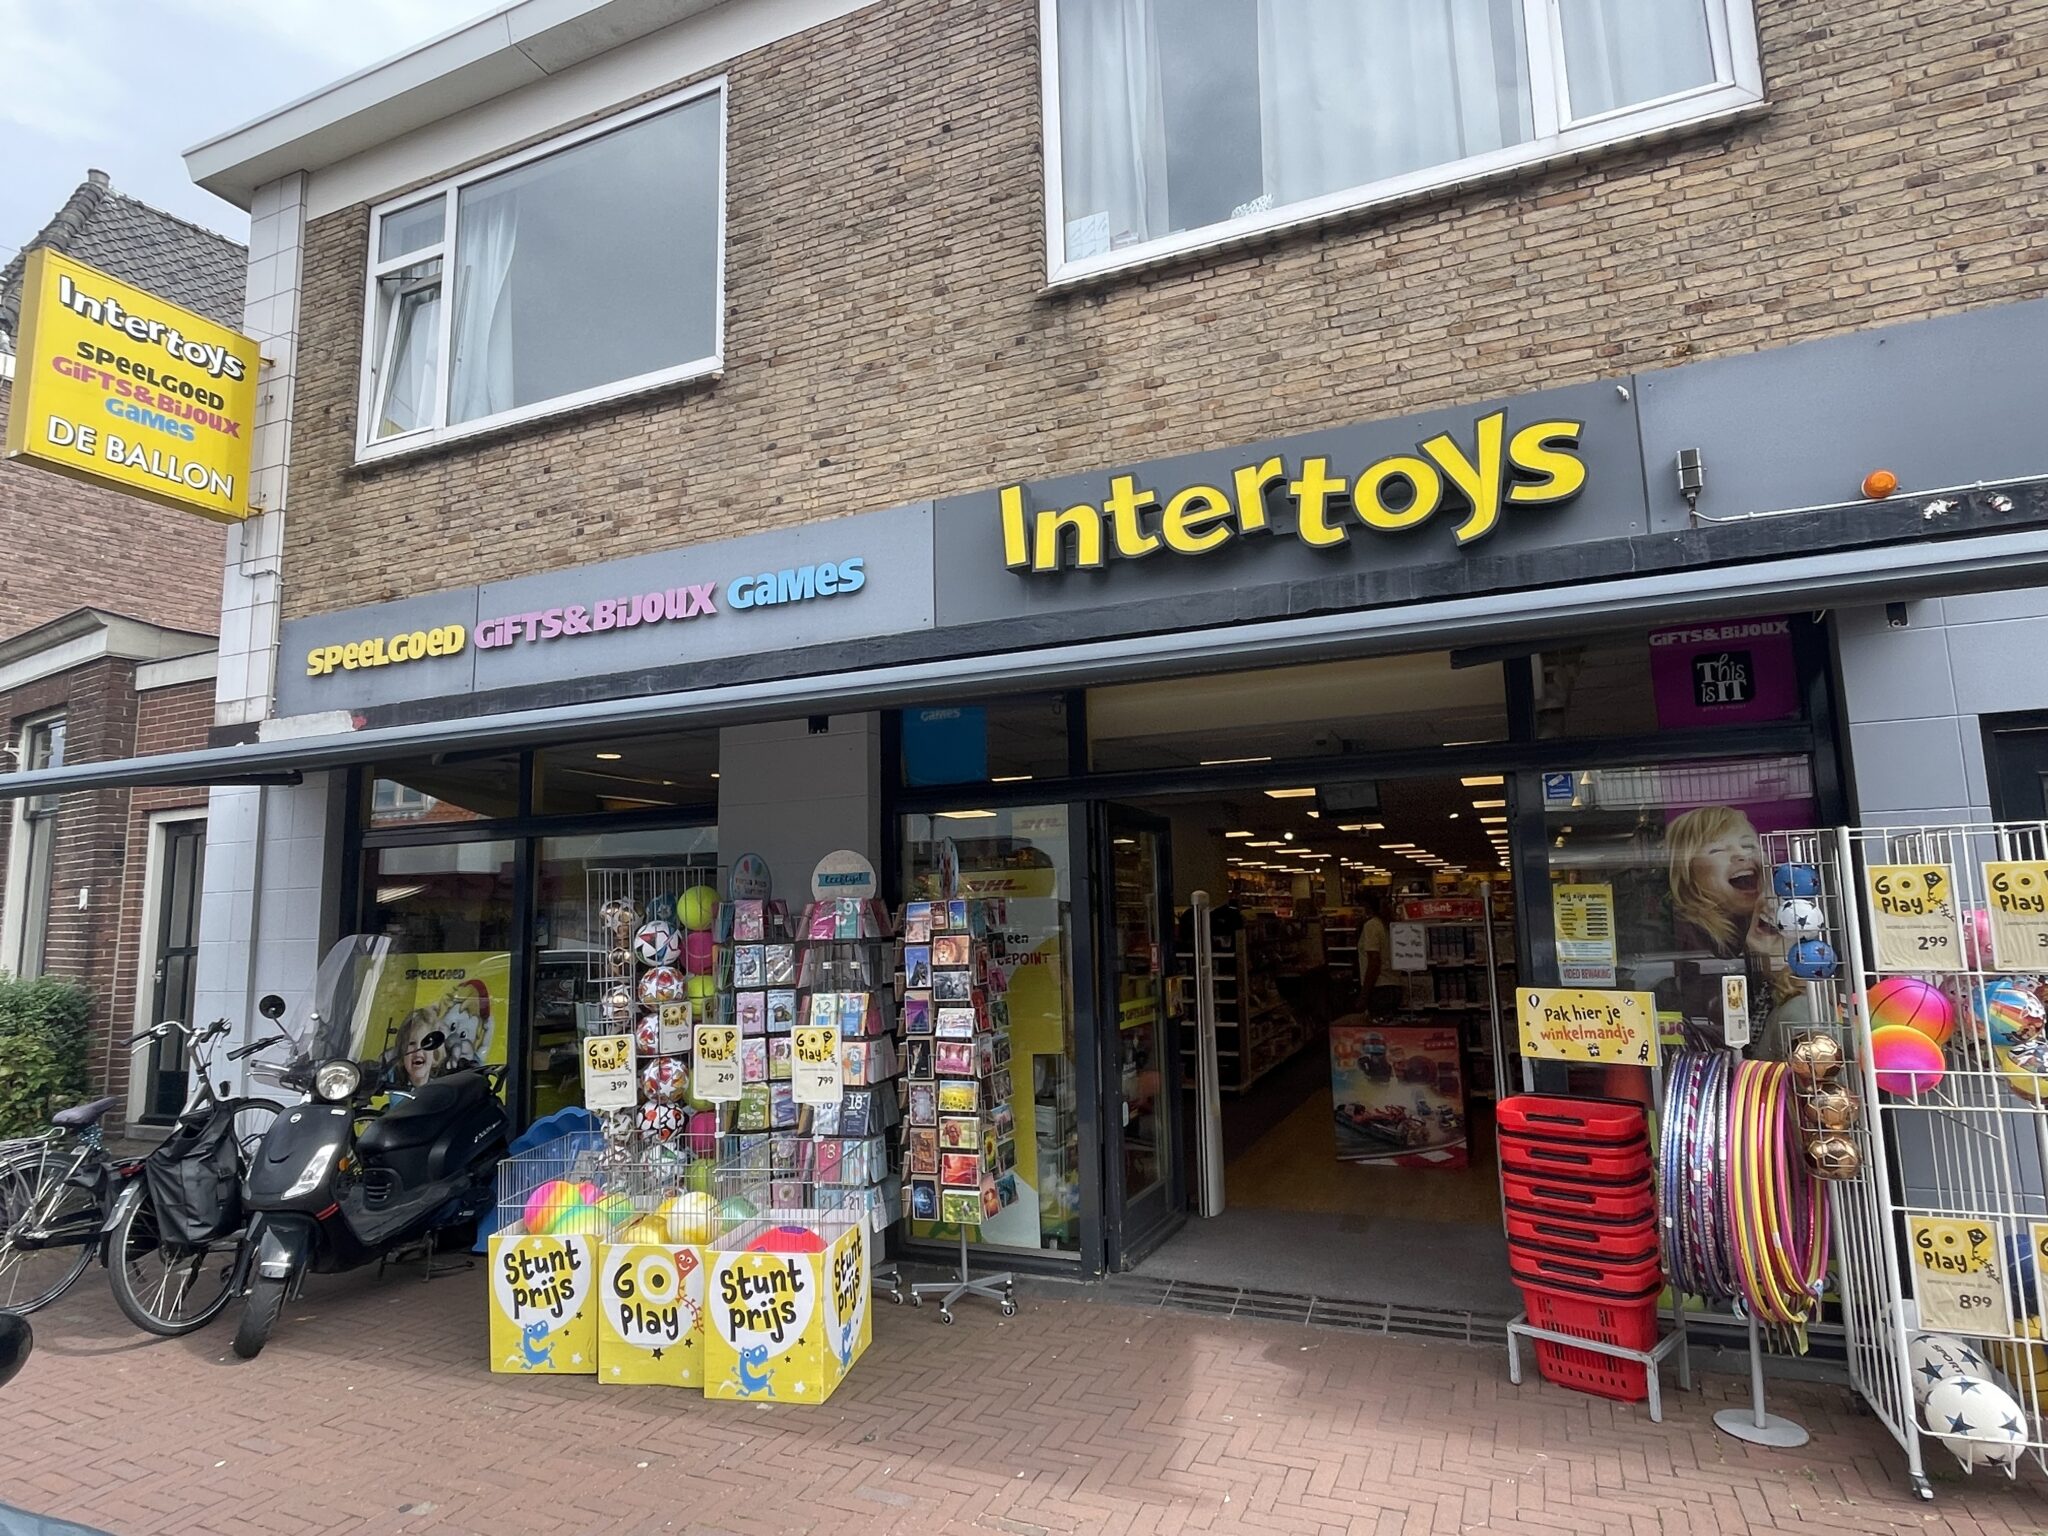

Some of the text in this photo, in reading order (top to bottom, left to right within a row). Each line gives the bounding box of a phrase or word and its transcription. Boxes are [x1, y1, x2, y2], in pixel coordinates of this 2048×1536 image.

[60, 274, 246, 383] Intertoys
[47, 414, 235, 501] DE BALLON
[1000, 407, 1589, 573] Intertoys
[1882, 897, 1924, 914] Play
[2000, 894, 2045, 912] Play
[1563, 967, 1580, 980] VIDEO
[1544, 1004, 1621, 1026] Pak hier je
[1540, 1024, 1636, 1045] winkelmandje
[591, 1058, 615, 1070] Play
[701, 1048, 724, 1060] Play
[799, 1049, 822, 1062] Play
[848, 1095, 863, 1110] 18
[504, 1239, 581, 1283] Stunt
[834, 1227, 862, 1291] Stunt
[1924, 1252, 1967, 1273] Play
[720, 1258, 804, 1304] Stunt
[513, 1275, 575, 1319] prijs
[837, 1270, 862, 1328] prijs
[621, 1302, 679, 1340] Play
[730, 1299, 797, 1343] prijs
